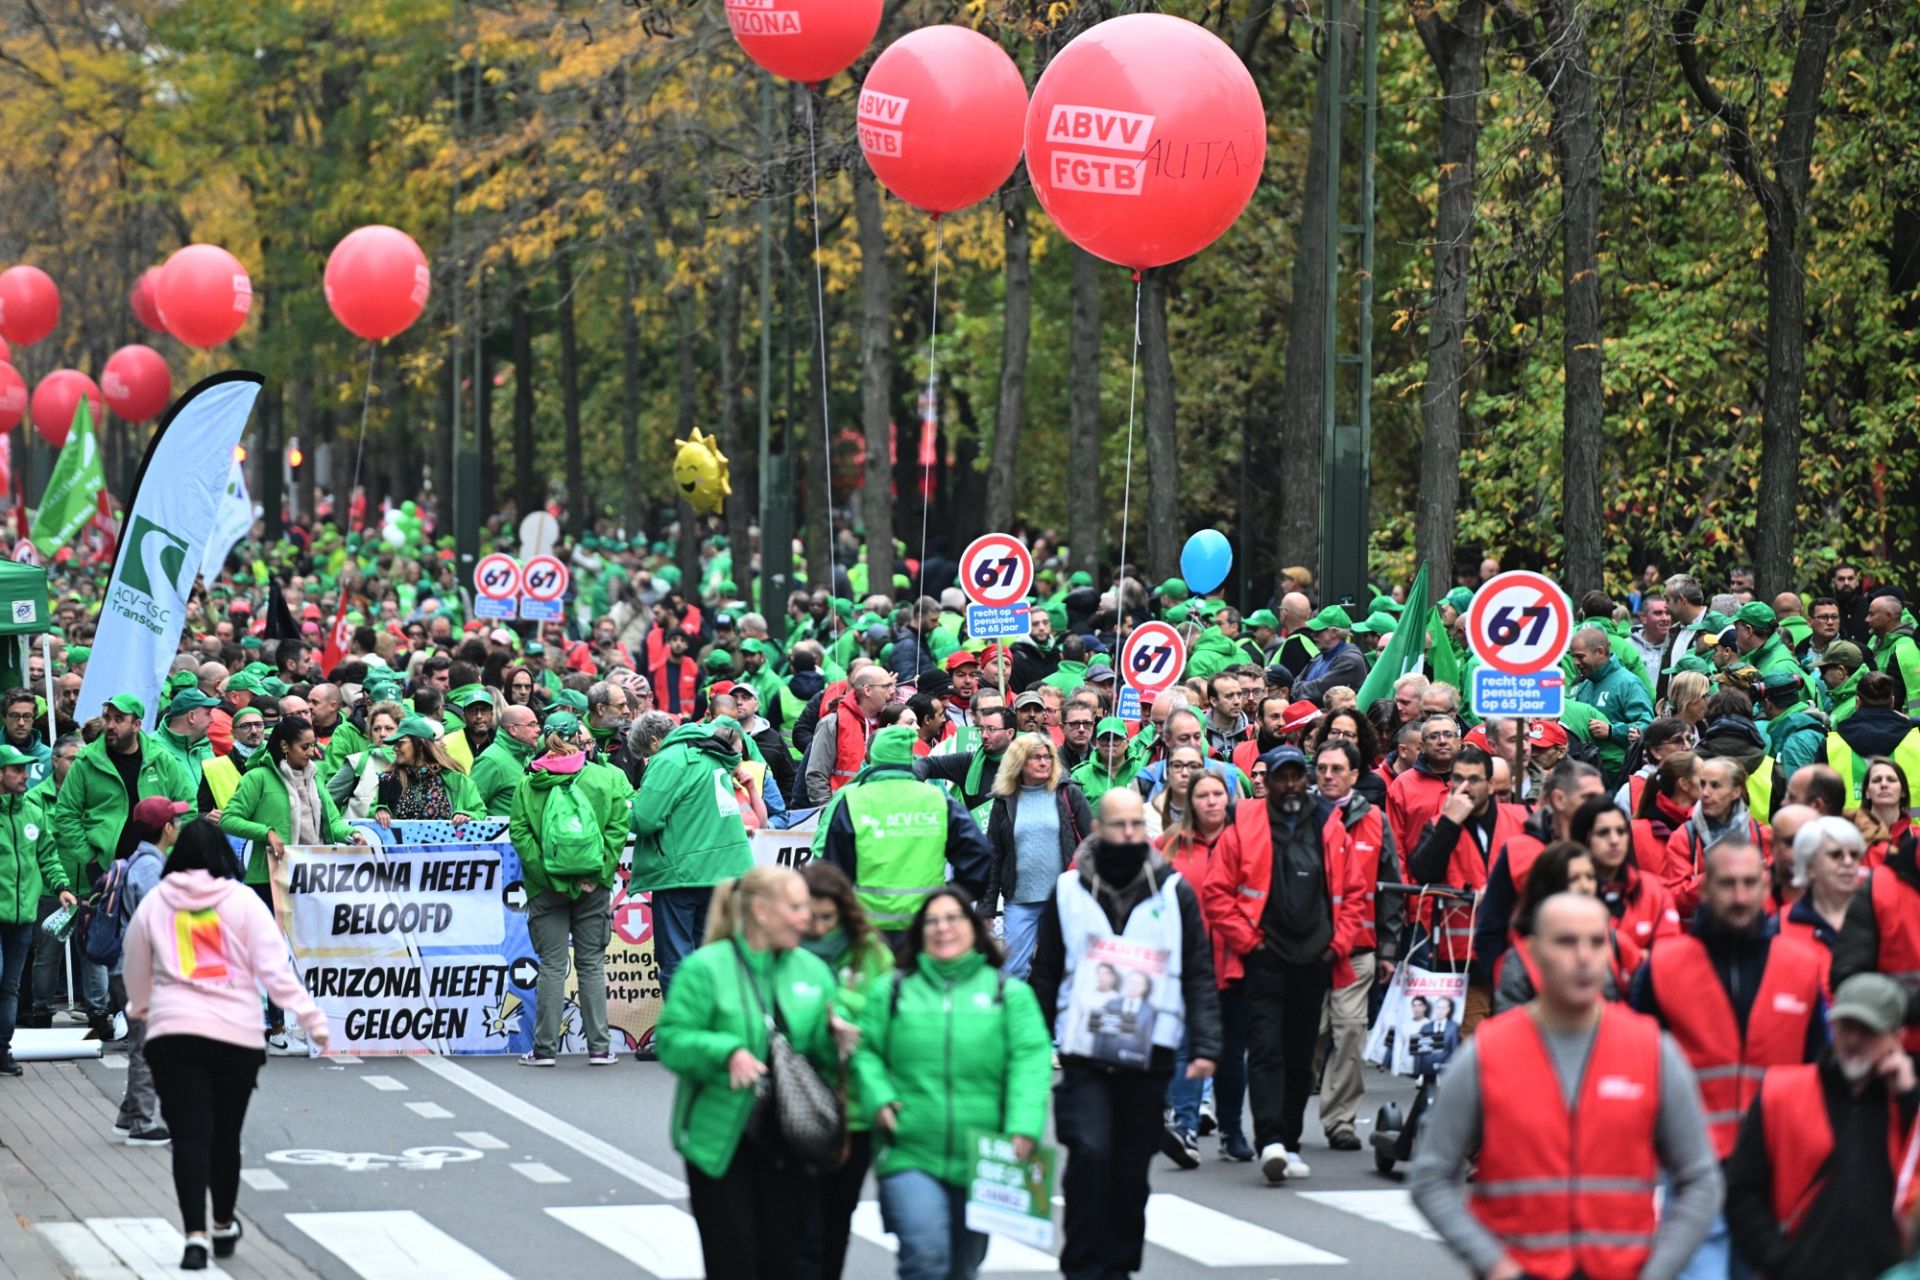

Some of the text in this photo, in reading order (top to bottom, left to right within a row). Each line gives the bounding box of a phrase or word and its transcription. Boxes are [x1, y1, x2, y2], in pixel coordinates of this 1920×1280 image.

[1053, 111, 1143, 144] ABVV
[1055, 158, 1136, 189] FGTB
[484, 569, 511, 586] 67
[529, 571, 557, 589] 67
[974, 557, 1018, 587] 67
[974, 609, 998, 617] recht
[1000, 609, 1011, 617] op
[975, 616, 1015, 626] pensioen
[1001, 624, 1019, 633] jaar
[1488, 606, 1550, 646] 67
[1132, 645, 1172, 673] 67
[1482, 676, 1517, 686] recht
[1519, 678, 1536, 688] op
[1482, 686, 1540, 700] pensioen
[1482, 698, 1546, 712] op 65 jaar
[289, 859, 500, 894] ARIZONA HEEFT
[331, 902, 452, 935] BELOOFD
[604, 950, 658, 967] erlag
[305, 965, 509, 998] ARIZONA HEEFT
[607, 969, 642, 982] van
[345, 1008, 468, 1041] GELOGEN
